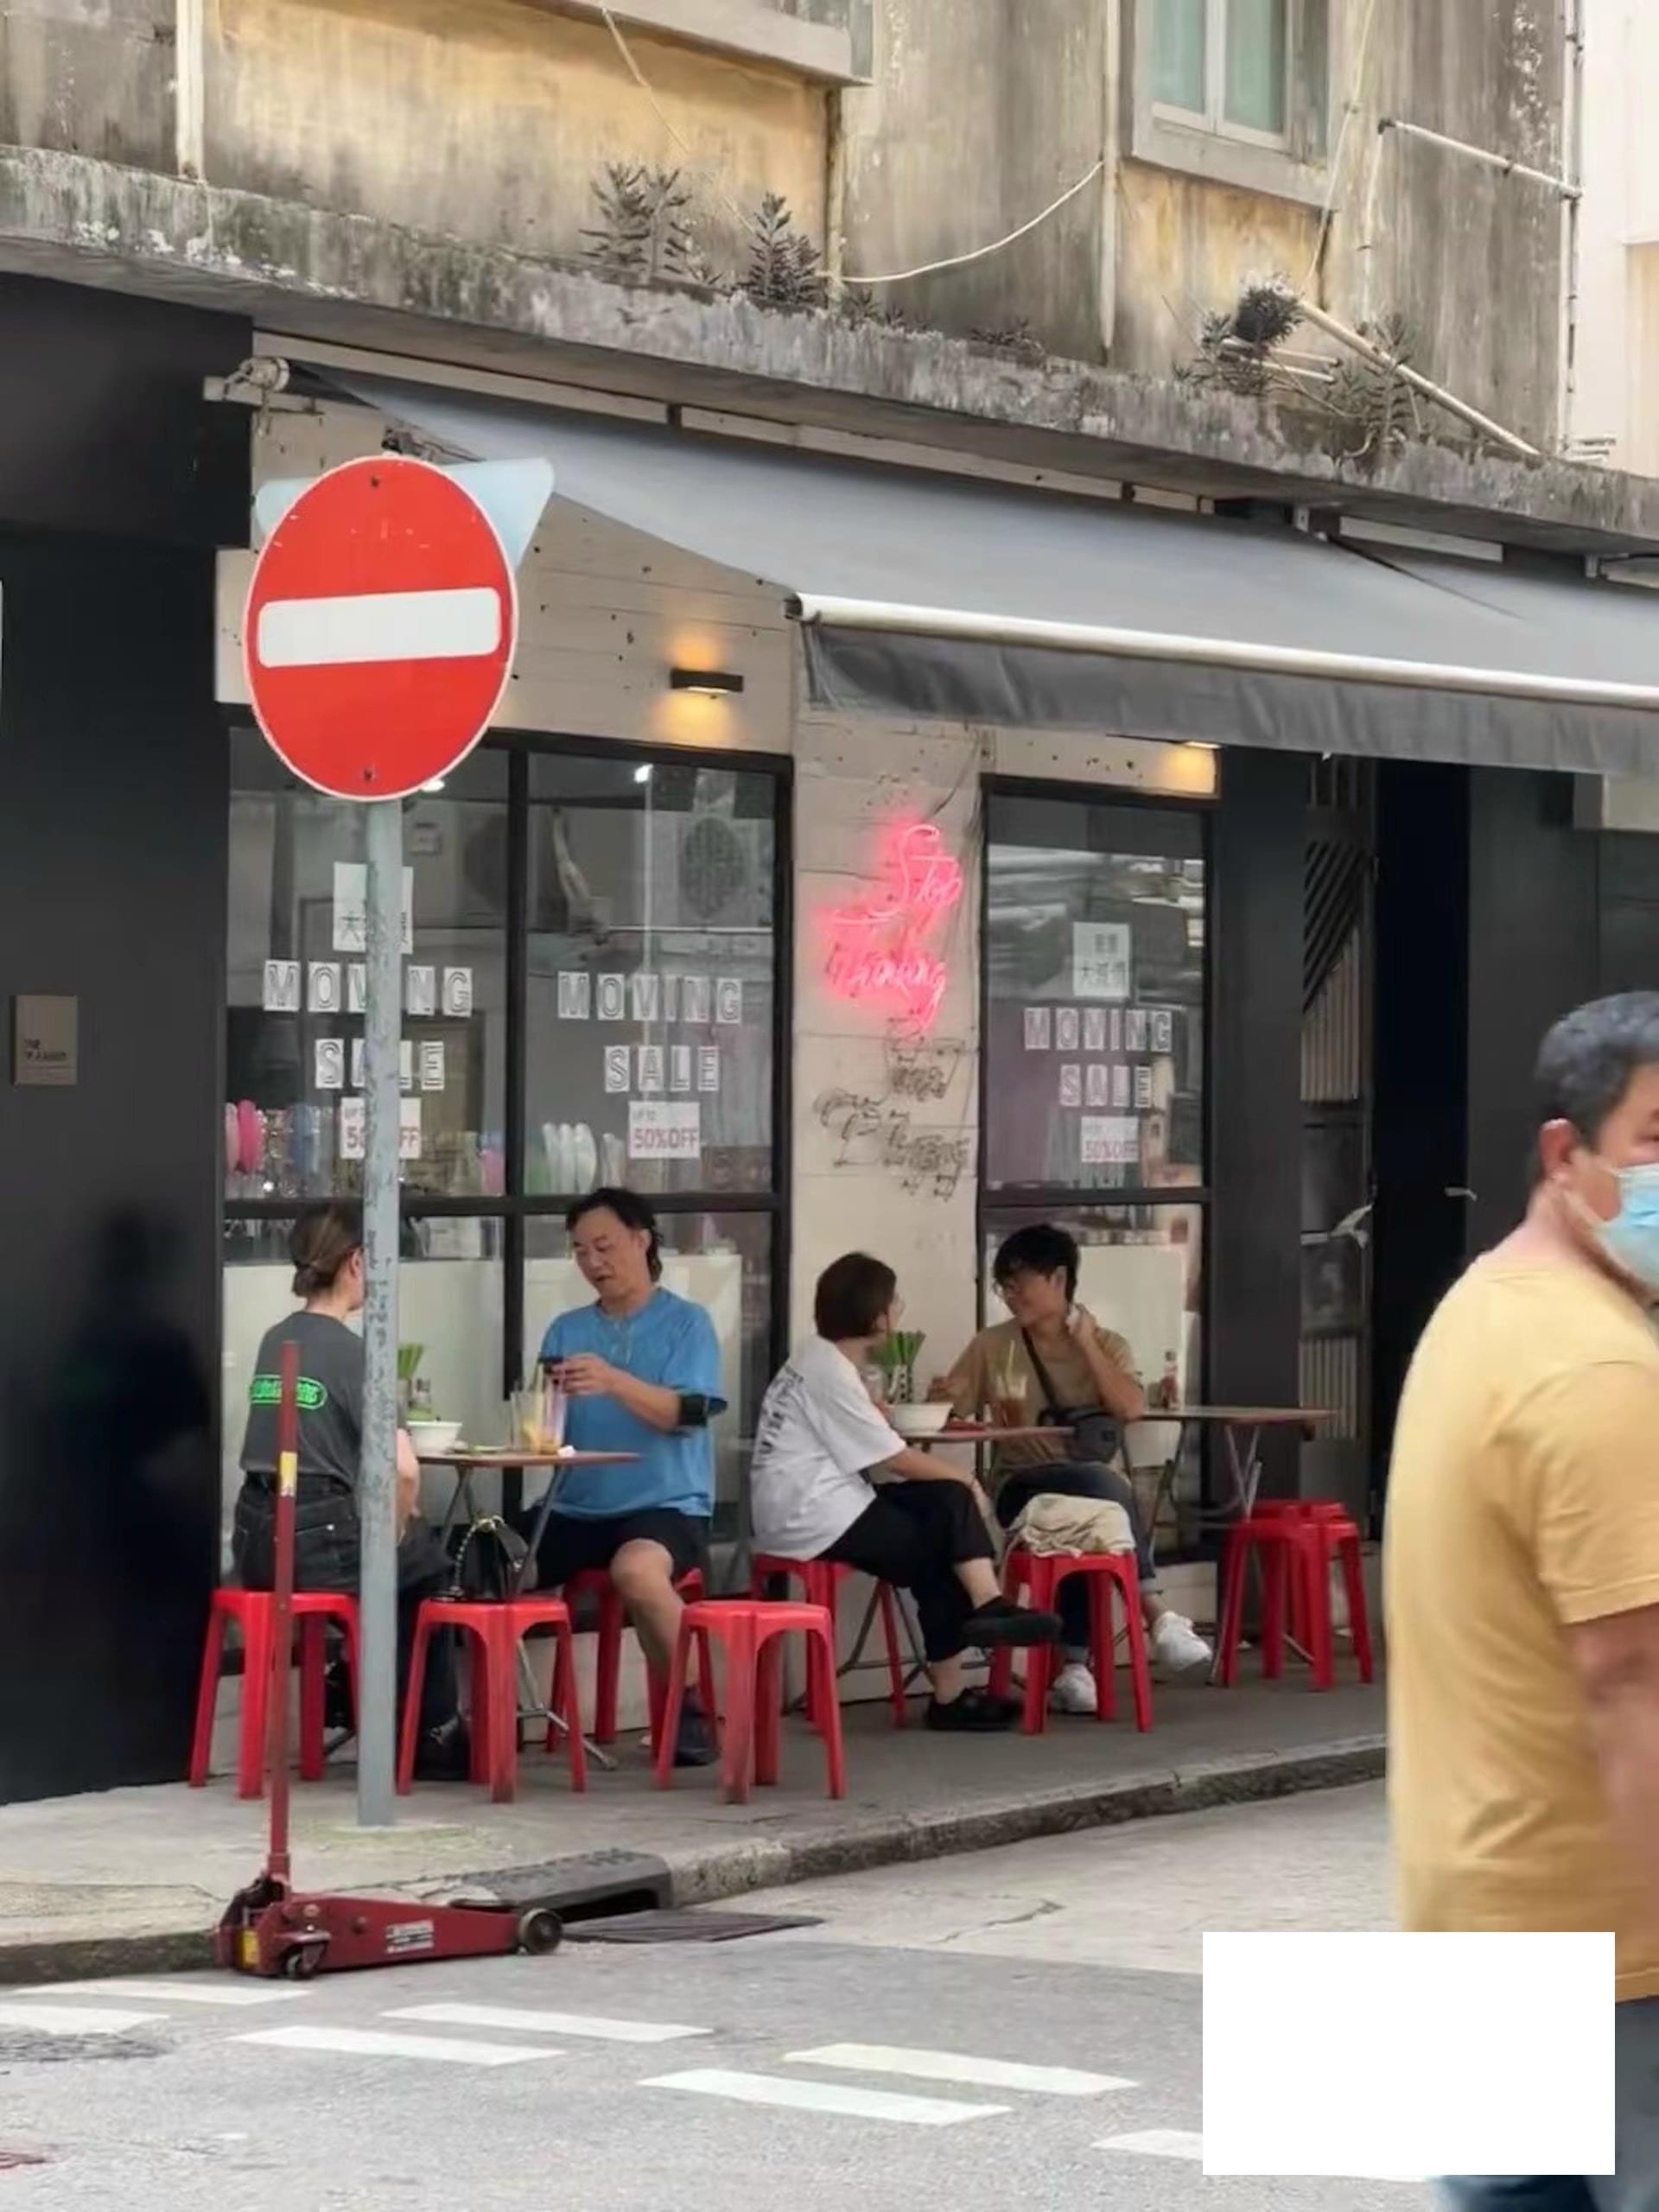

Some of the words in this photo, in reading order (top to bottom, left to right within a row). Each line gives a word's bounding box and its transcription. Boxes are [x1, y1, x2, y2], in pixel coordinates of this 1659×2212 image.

[264, 962, 472, 1016] MOVNG
[559, 973, 741, 1022] MOVING
[1025, 1008, 1172, 1051] MOVING
[316, 1039, 444, 1089] SE
[606, 1046, 719, 1092] SALE
[1061, 1065, 1151, 1107] SALE
